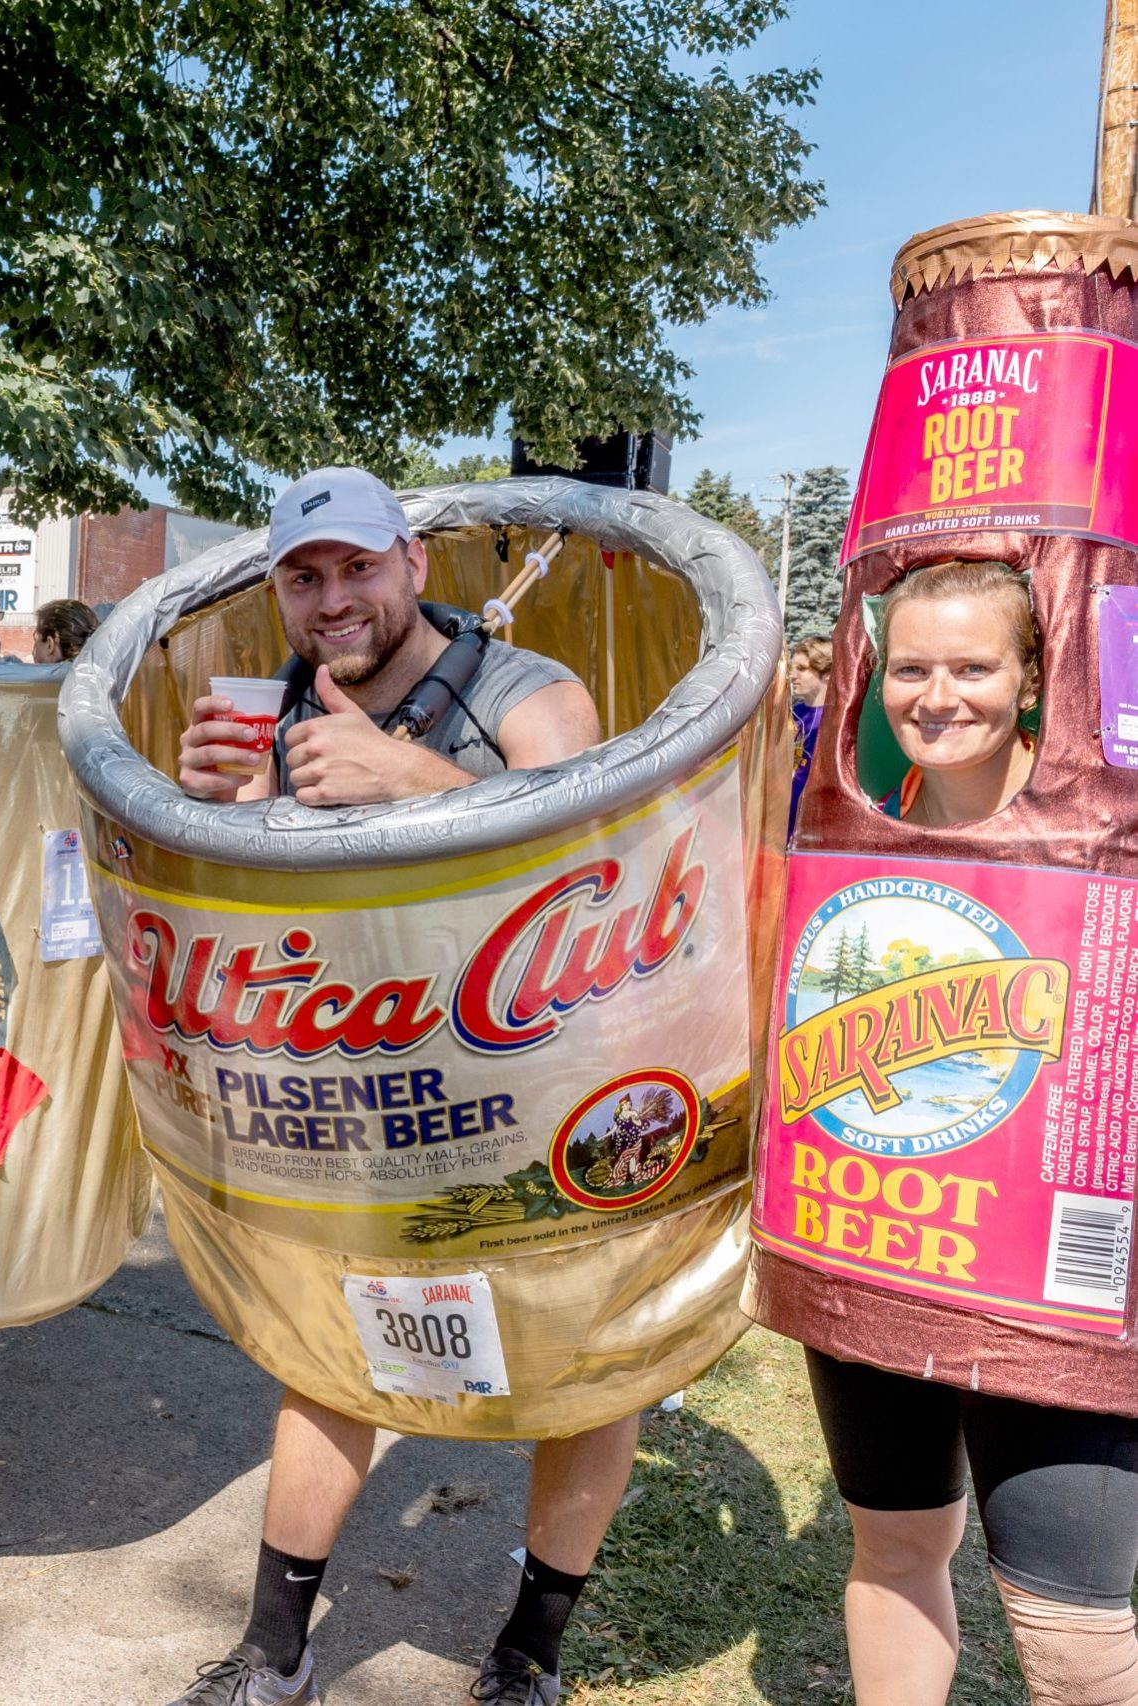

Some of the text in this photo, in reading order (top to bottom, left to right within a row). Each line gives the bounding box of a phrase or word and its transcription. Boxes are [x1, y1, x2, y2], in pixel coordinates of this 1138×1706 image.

[916, 349, 1043, 407] SARANAC
[950, 391, 996, 409] 1888
[923, 405, 1020, 461] ROOT
[929, 447, 1025, 505] BEER
[885, 514, 1041, 540] HAND CRAFTED SOFT DRINKS
[925, 507, 991, 521] WORLD FAMOUS
[128, 822, 707, 1057] Utica Club
[789, 880, 1000, 997] FAMOUS HANDCRAFTED
[1123, 948, 1138, 996] STARCH
[782, 963, 1062, 1109] SARANAC
[1057, 881, 1101, 1186] INGREDIENTS: FILTERED WATER, HIGH FRUCTOSE
[1073, 884, 1118, 1188] CORN SYRUP, CARMEL COLOR, SODIUM BENZOATE
[1092, 886, 1135, 1190] (preserves freshness), NATURAL & ARTIFICIAL FLAVORS,
[1120, 997, 1135, 1031] FOOD
[1115, 1034, 1130, 1091] MODIFIED
[215, 1067, 452, 1112] PILSENER
[1111, 1093, 1124, 1118] AND
[221, 1092, 521, 1152] LAGER BEER
[842, 1094, 1010, 1156] SOFT DRINKS
[1040, 1083, 1064, 1184] CAFFEINE FREE
[1109, 1120, 1122, 1150] ACID
[1124, 1113, 1138, 1162] Brewing
[232, 1145, 282, 1165] BREWED
[284, 1154, 324, 1169] FROM
[325, 1157, 359, 1170] BEST
[361, 1153, 423, 1171] QUALITY
[469, 1130, 529, 1155] GRAINS,
[234, 1158, 259, 1174] AND
[259, 1162, 322, 1181] CHOICEST
[369, 1160, 459, 1181] ABSOLUTELY
[462, 1151, 506, 1169] PURE.
[1106, 1153, 1120, 1192] CITRIC
[791, 1141, 1000, 1228] ROOT
[1121, 1163, 1135, 1194] Matt
[479, 1238, 506, 1249] First
[506, 1233, 531, 1247] beer
[532, 1228, 557, 1242] sold
[558, 1226, 570, 1236] in
[571, 1223, 589, 1235] the
[590, 1211, 629, 1230] United
[630, 1202, 666, 1220] States
[667, 1191, 691, 1207] after
[793, 1193, 977, 1283] BEER
[421, 1284, 475, 1306] SARANAC
[375, 1308, 472, 1359] 3808
[464, 1380, 493, 1394] PAR
